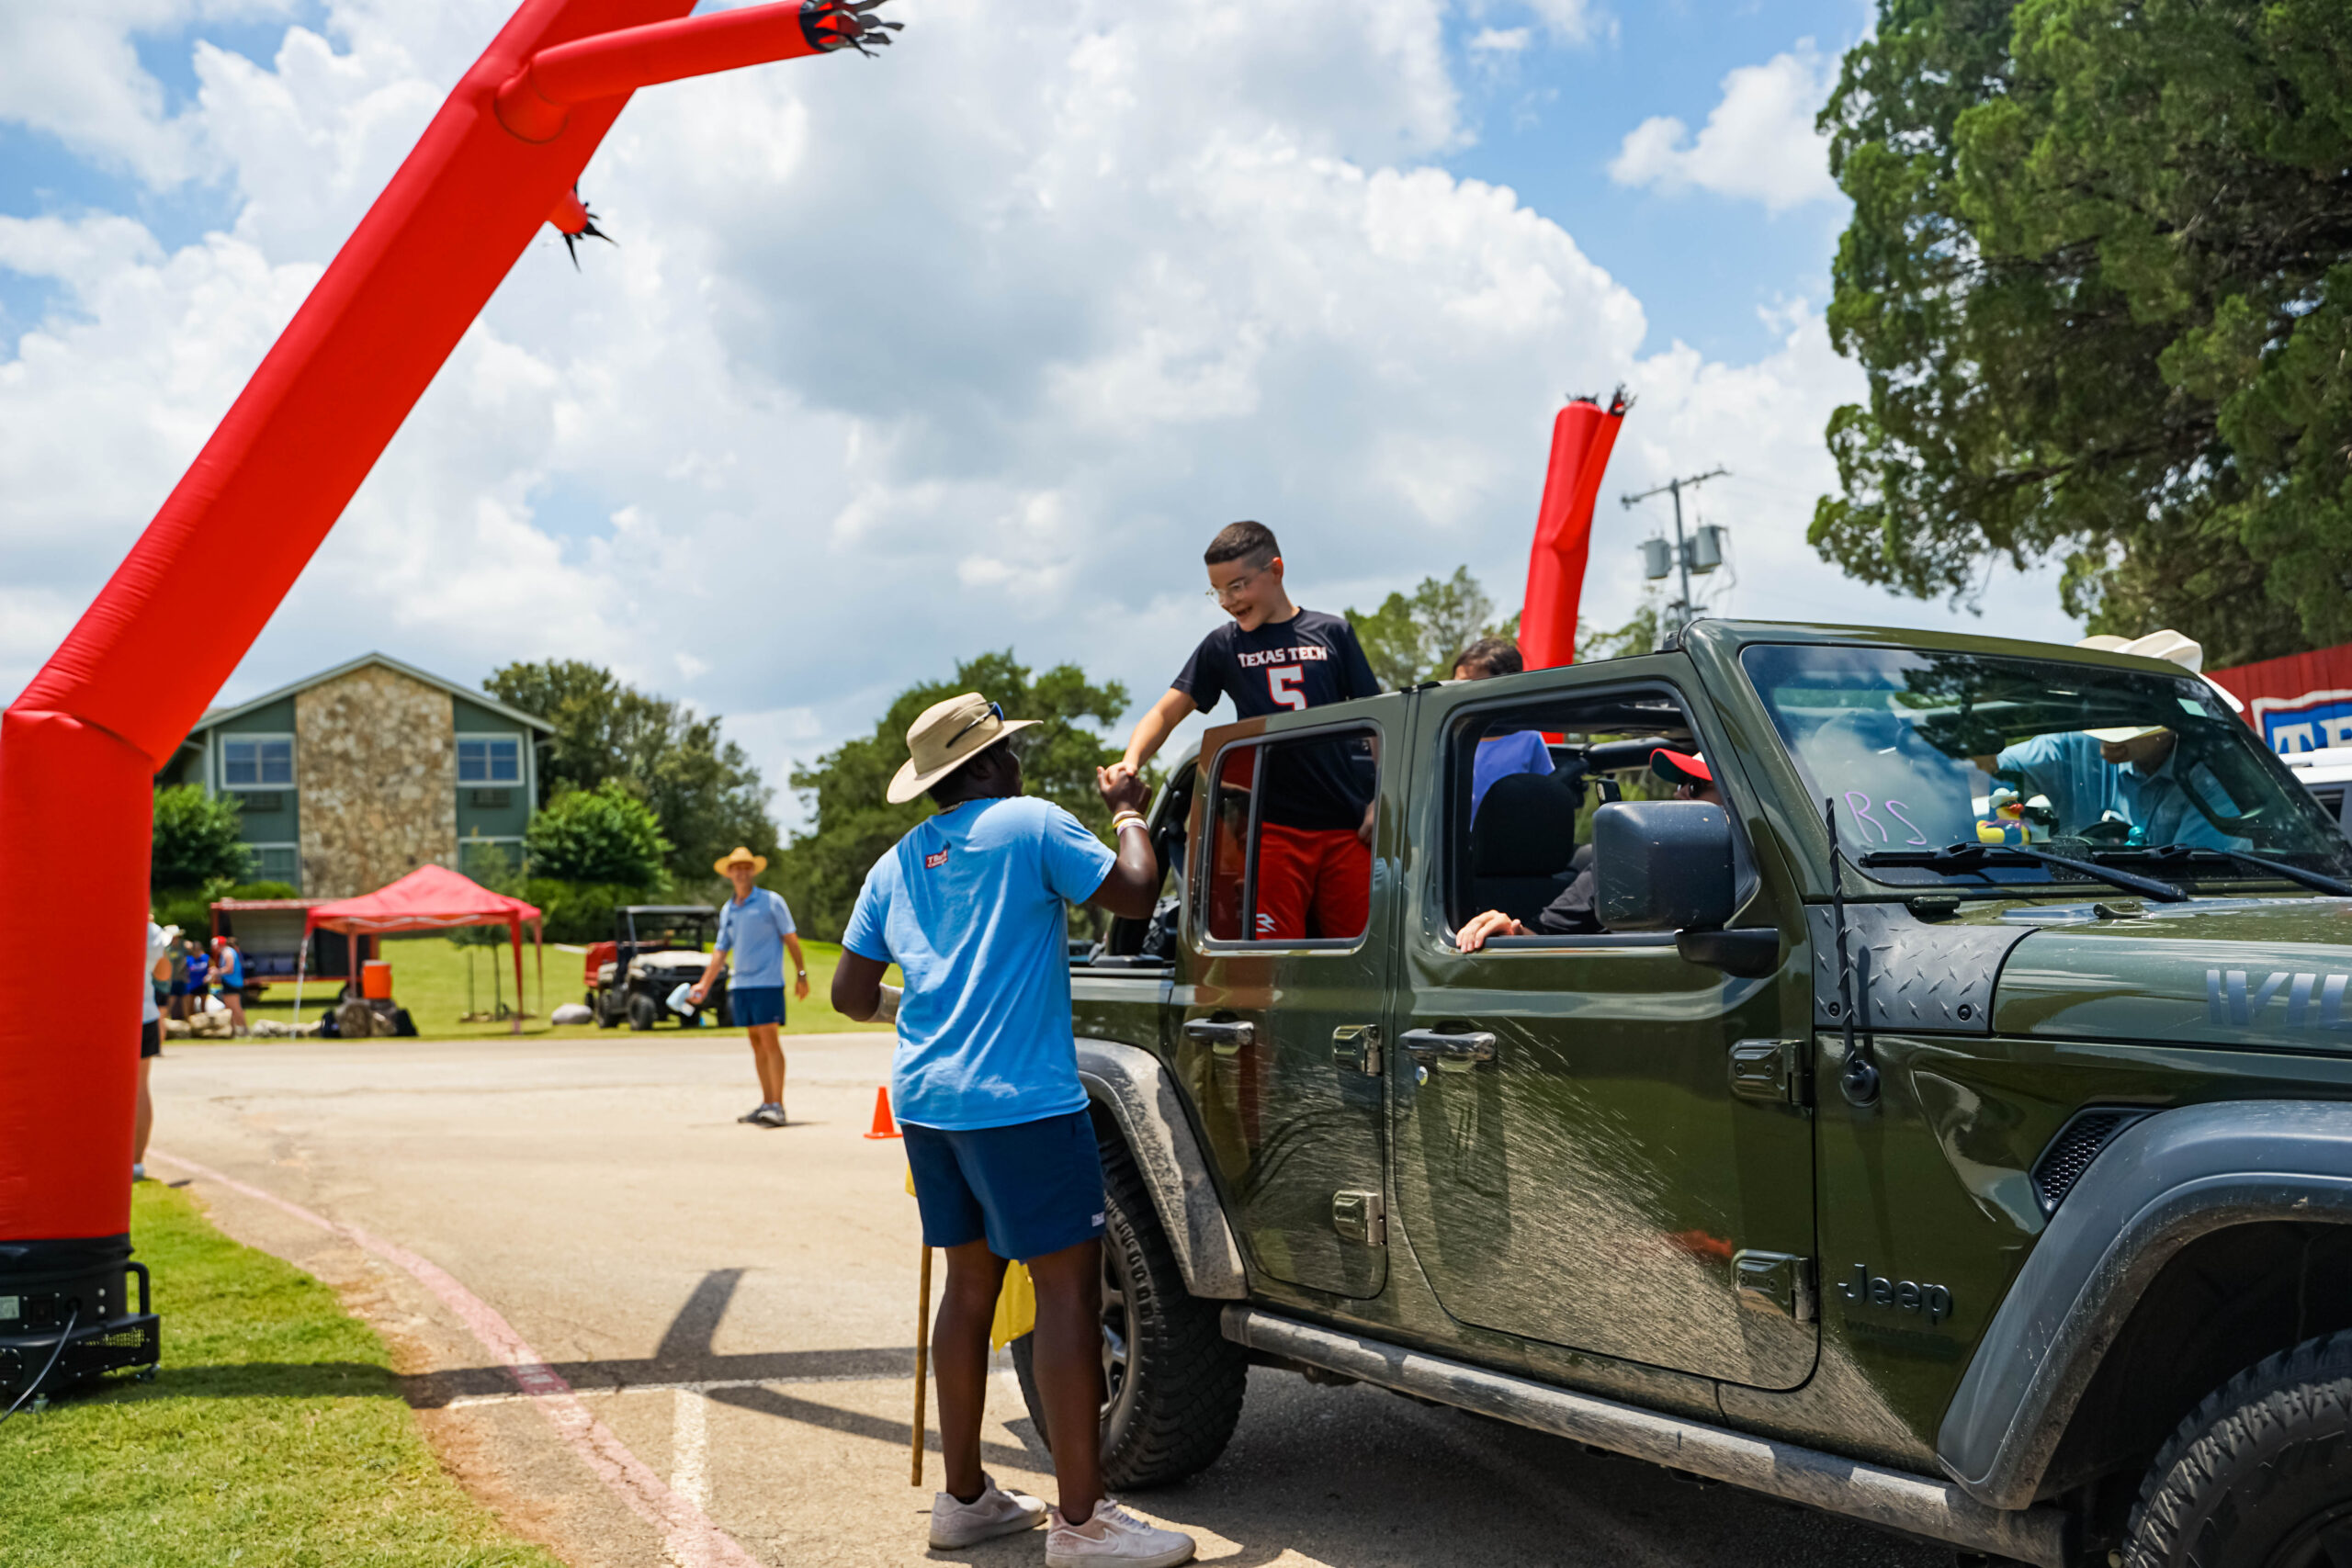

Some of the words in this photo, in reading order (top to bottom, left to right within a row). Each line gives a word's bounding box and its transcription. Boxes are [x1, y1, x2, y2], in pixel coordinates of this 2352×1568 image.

[1238, 649, 1286, 668] TEXAS
[1288, 647, 1328, 660] TECH
[1266, 663, 1308, 711] 5
[1844, 791, 1927, 845] RS
[1838, 1263, 1952, 1325] Jeep
